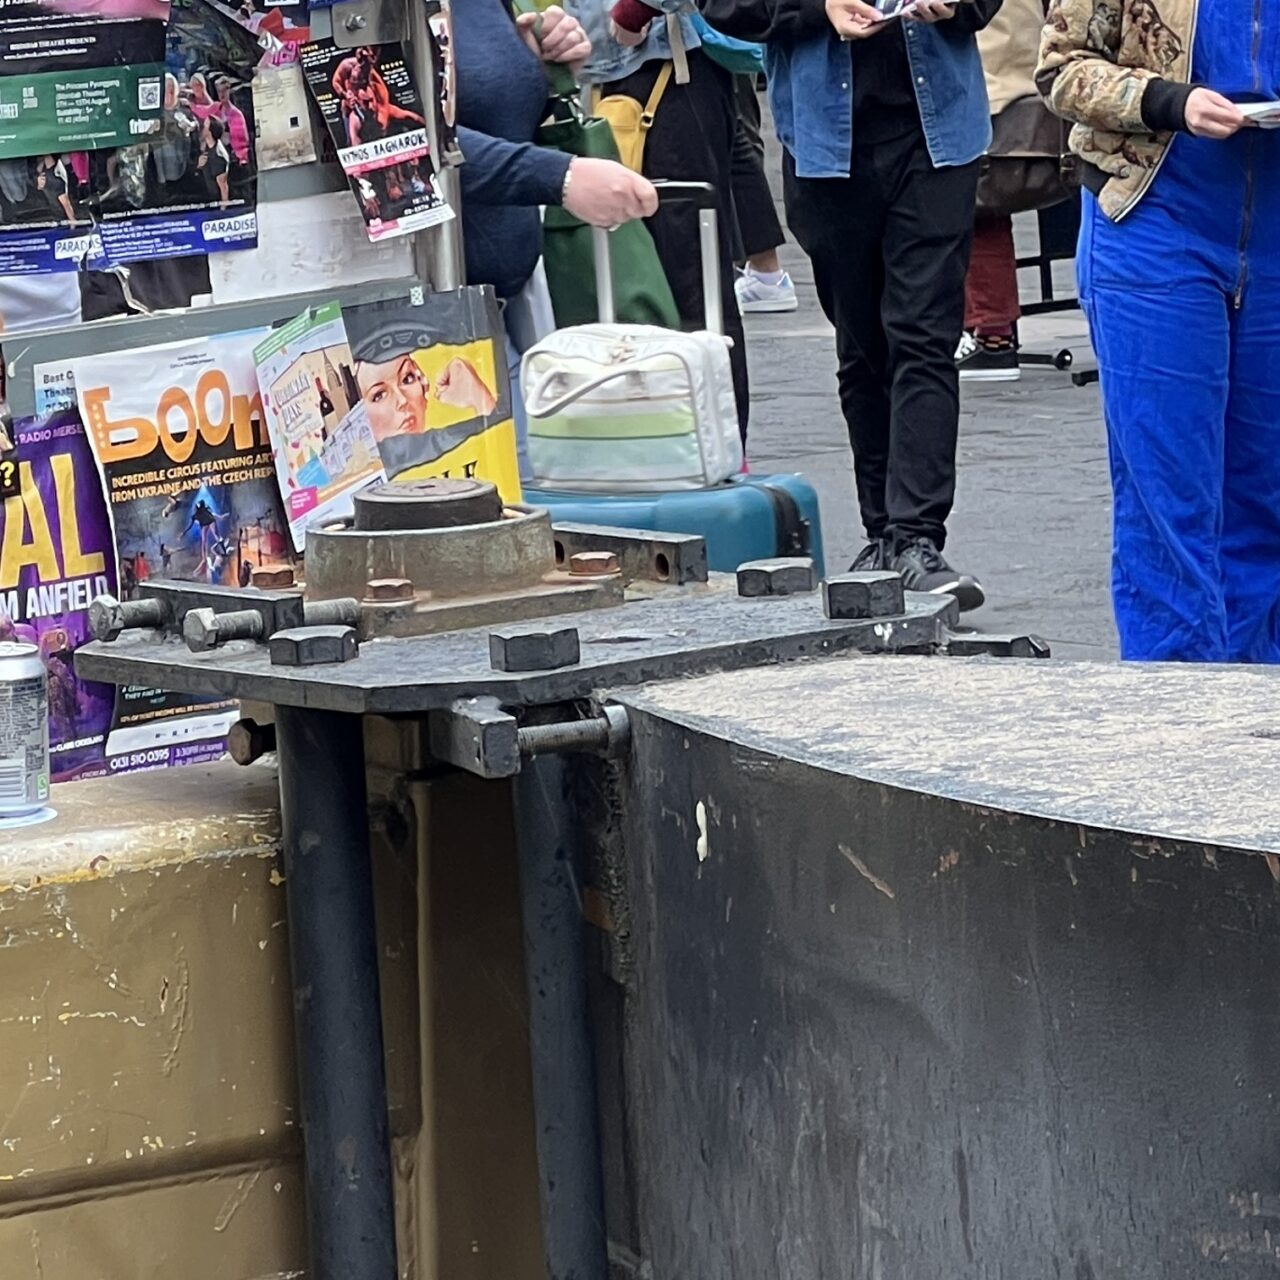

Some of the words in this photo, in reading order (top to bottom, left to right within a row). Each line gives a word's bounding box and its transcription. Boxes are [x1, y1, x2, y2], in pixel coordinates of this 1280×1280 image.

[373, 132, 426, 155] RAGNAROK
[204, 218, 256, 233] PARADISE
[43, 372, 65, 384] Best
[43, 387, 76, 399] Theatr
[19, 429, 52, 444] RADIO
[53, 423, 84, 438] MERSE
[112, 472, 166, 489] INCREDIBLE
[167, 467, 201, 481] CIRCUS
[202, 455, 253, 475] FEATURING
[111, 488, 136, 503] FROM
[136, 483, 180, 500] UKRAINE
[181, 479, 202, 493] AND
[204, 474, 222, 487] THE
[223, 469, 255, 483] CZECH
